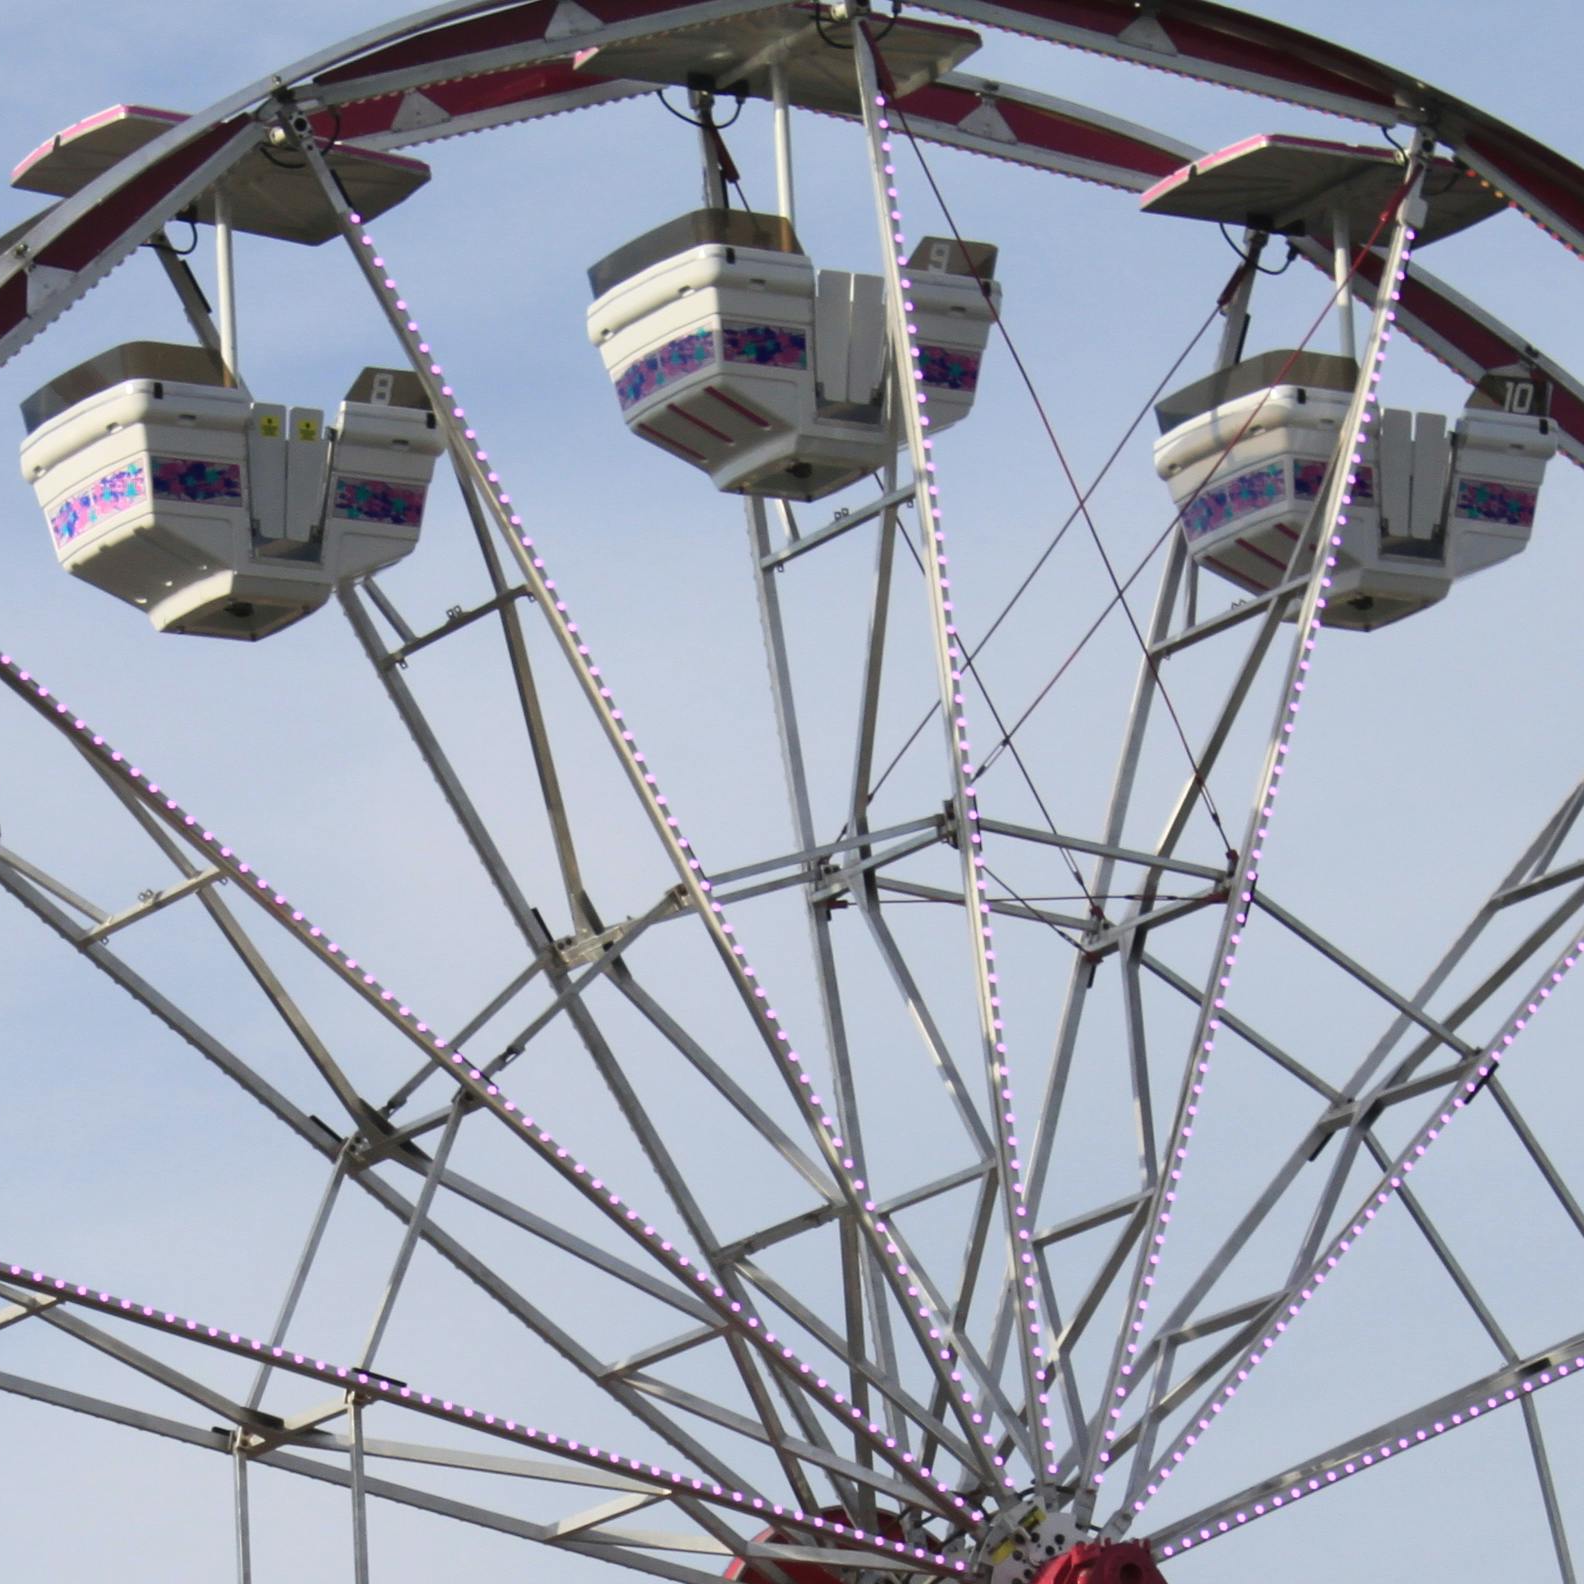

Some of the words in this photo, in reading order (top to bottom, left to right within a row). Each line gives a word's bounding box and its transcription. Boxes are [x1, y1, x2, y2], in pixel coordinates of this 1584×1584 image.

[928, 243, 949, 273] 9
[371, 374, 393, 405] 8
[1503, 382, 1534, 413] 10
